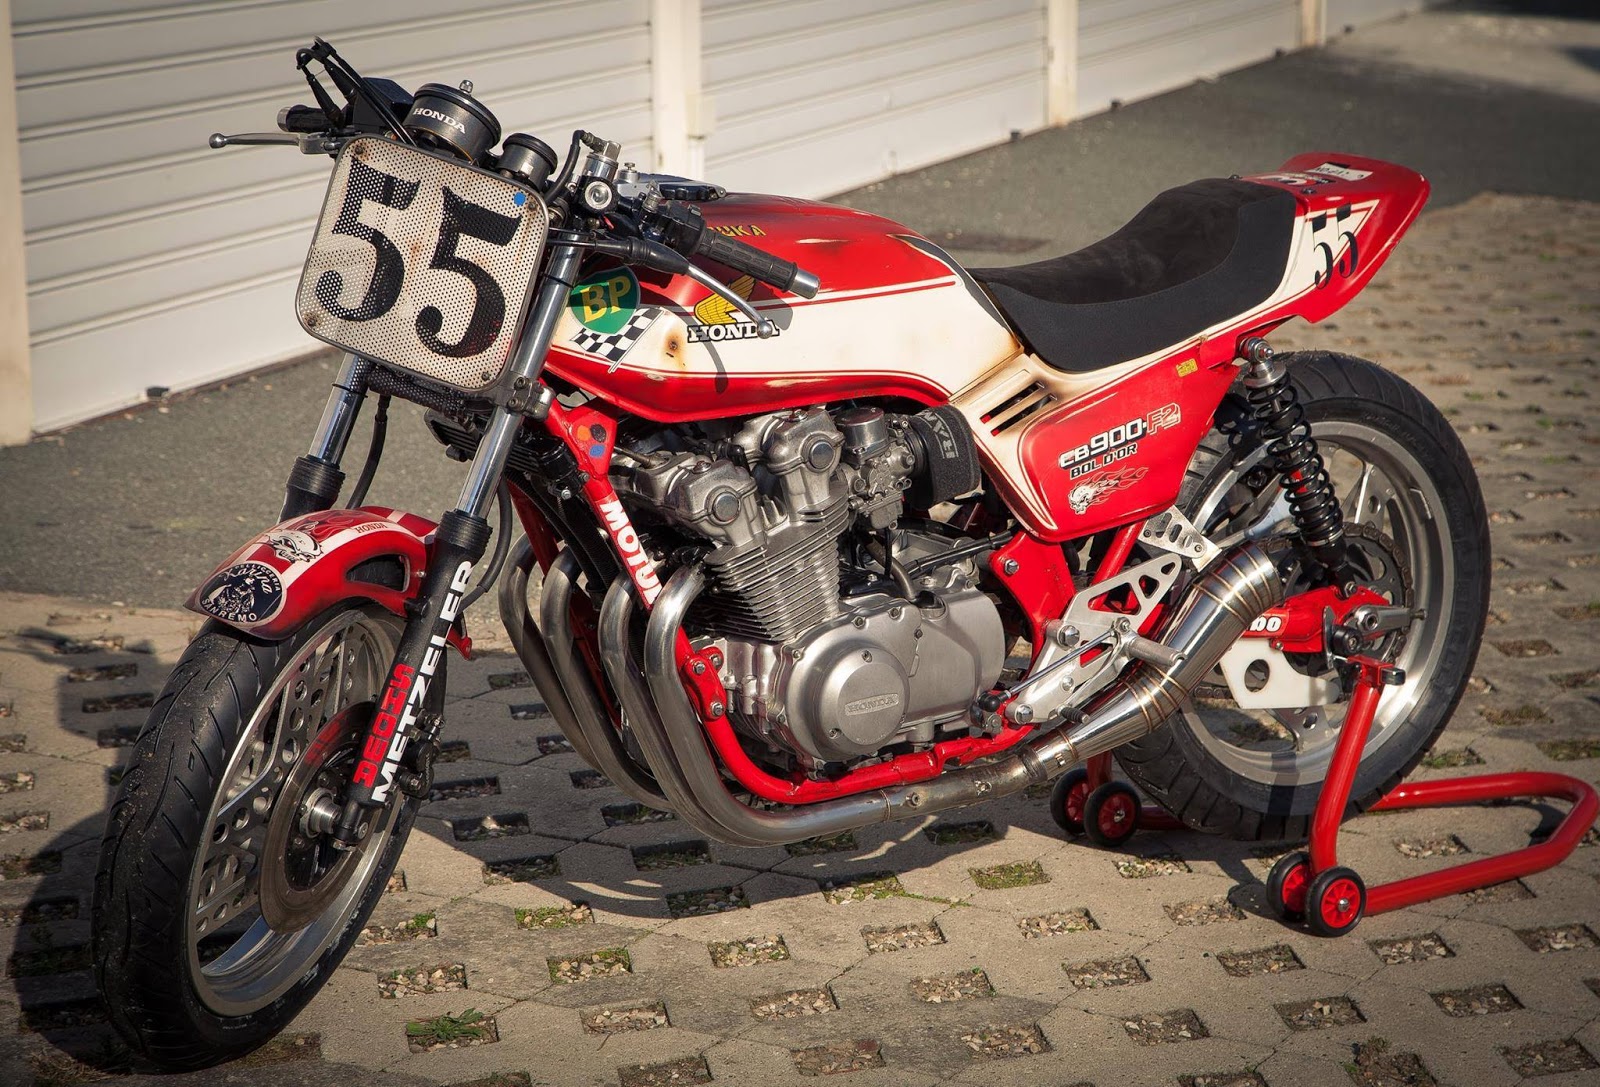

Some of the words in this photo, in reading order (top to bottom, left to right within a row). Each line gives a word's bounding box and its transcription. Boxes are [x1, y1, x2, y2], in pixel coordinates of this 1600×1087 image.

[412, 108, 466, 134] HONDA
[315, 155, 523, 358] 55
[1311, 203, 1359, 290] 55
[579, 275, 632, 324] BP
[1070, 458, 1101, 480] BOL
[1103, 442, 1138, 466] D'OR
[355, 522, 388, 534] HONDA
[371, 560, 473, 802] METZELER
[352, 663, 416, 789] SHOWA
